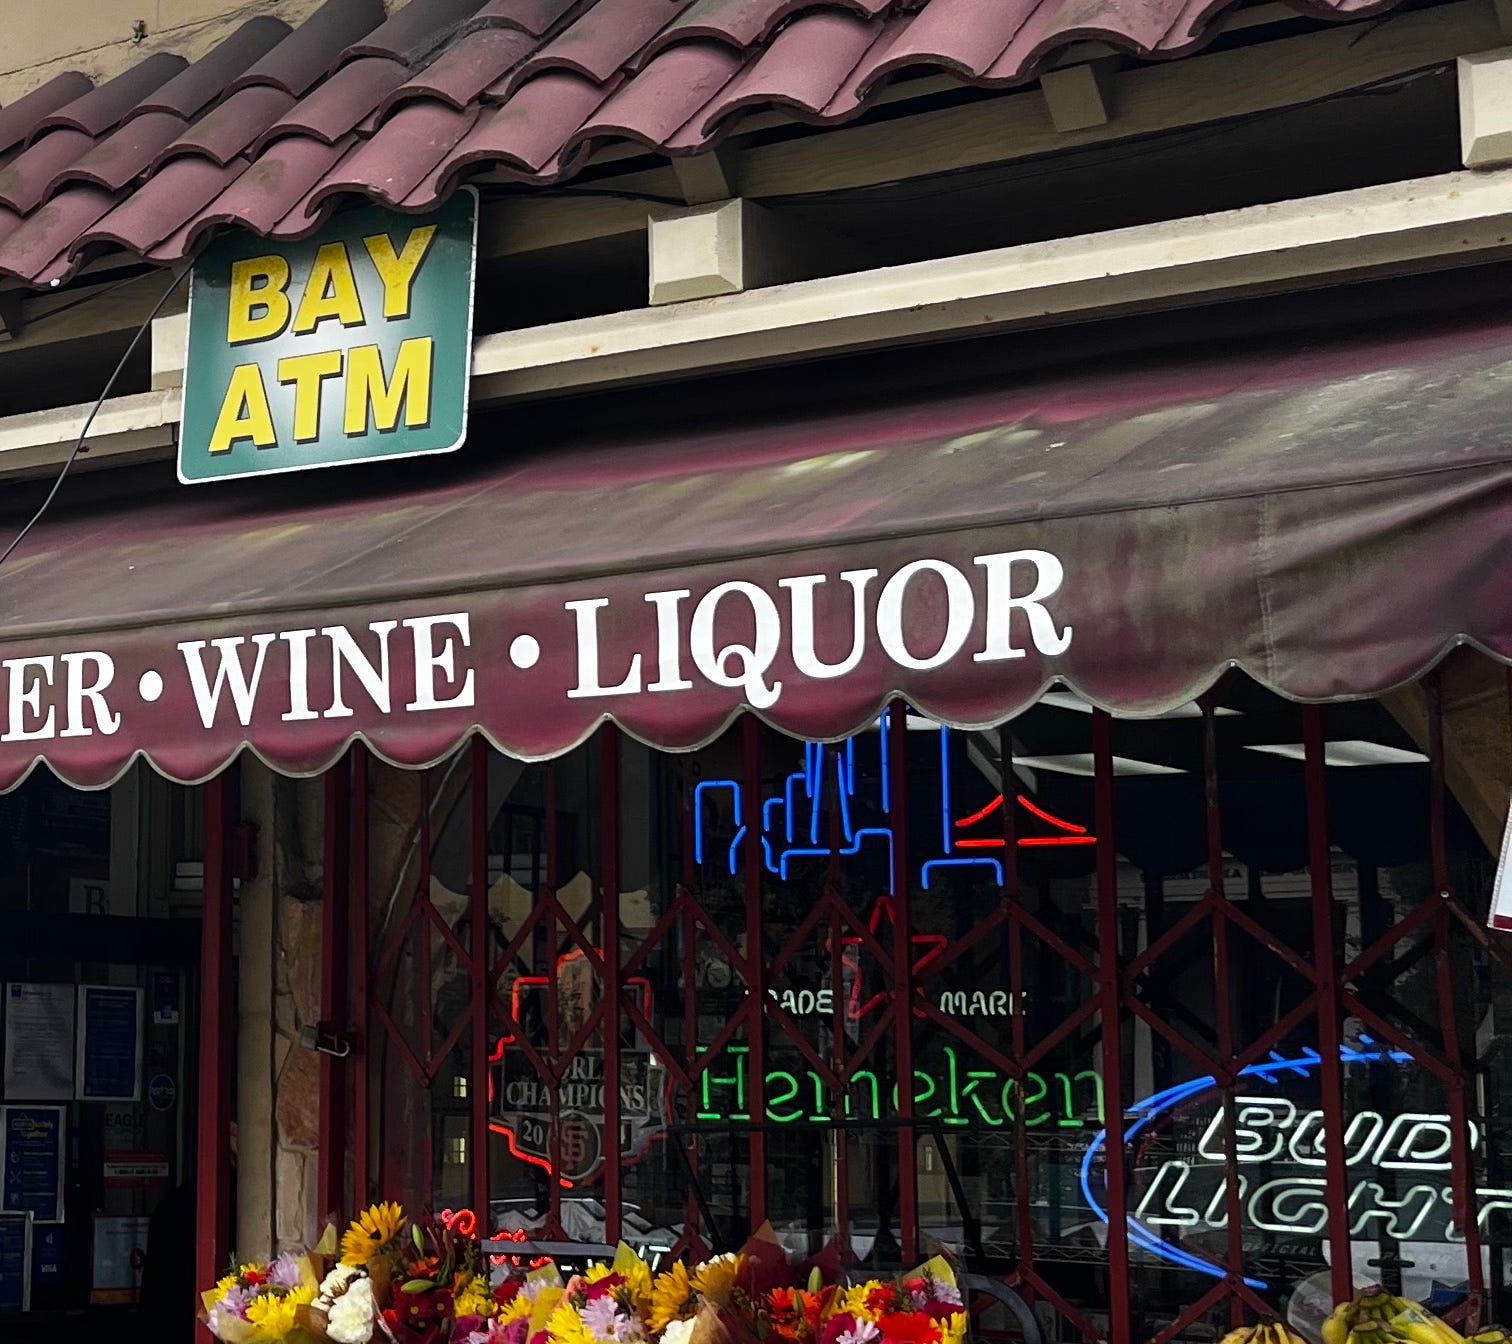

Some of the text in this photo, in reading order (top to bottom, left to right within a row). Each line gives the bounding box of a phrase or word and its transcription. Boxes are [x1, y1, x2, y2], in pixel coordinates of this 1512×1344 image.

[226, 224, 438, 347] BAY
[207, 336, 434, 456] ATM
[178, 611, 475, 730] WINE
[564, 548, 1073, 711] LIQUOR
[694, 1045, 1106, 1128] Heineken
[1197, 1094, 1479, 1170] BUD
[1134, 1160, 1512, 1241] LIGHT
